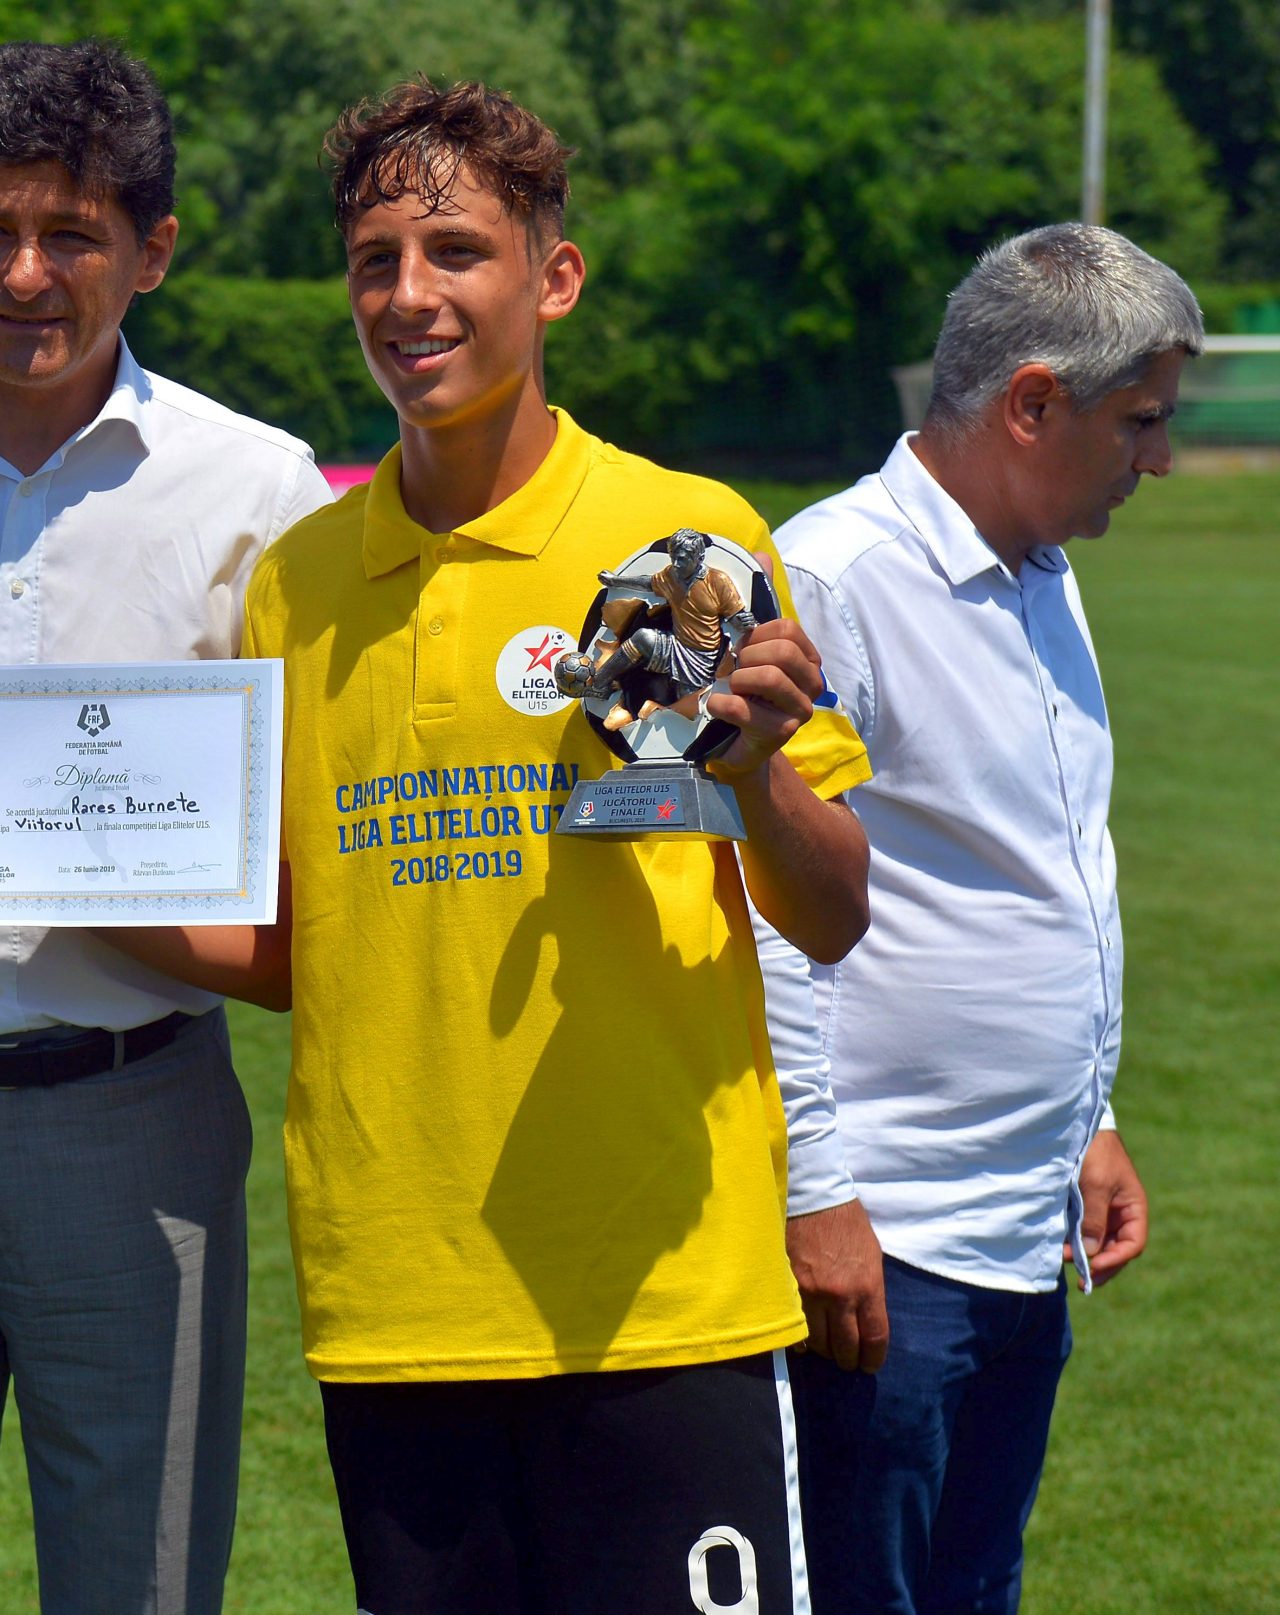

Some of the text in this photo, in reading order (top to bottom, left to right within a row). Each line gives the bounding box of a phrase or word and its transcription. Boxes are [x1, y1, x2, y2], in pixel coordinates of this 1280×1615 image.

[522, 678, 556, 688] LIGA
[512, 690, 565, 699] ELITELOR
[528, 701, 548, 709] U15
[87, 714, 101, 724] FRF
[54, 764, 131, 791] Diplomă
[335, 770, 438, 813] CAMPION
[594, 785, 670, 795] LIGA ELITELOR U15
[5, 792, 200, 817] Se acordă jucătorului Rares Burnete
[602, 797, 657, 807] JUCĂTORUL
[611, 808, 646, 816] FINALEI
[15, 817, 82, 831] Viitorul
[103, 822, 122, 831] finala
[158, 821, 172, 832] Liga
[172, 820, 195, 829] Elitelor
[338, 818, 383, 854] LIGA
[389, 806, 522, 845] ELITELOR
[390, 850, 522, 887] 2018-2019
